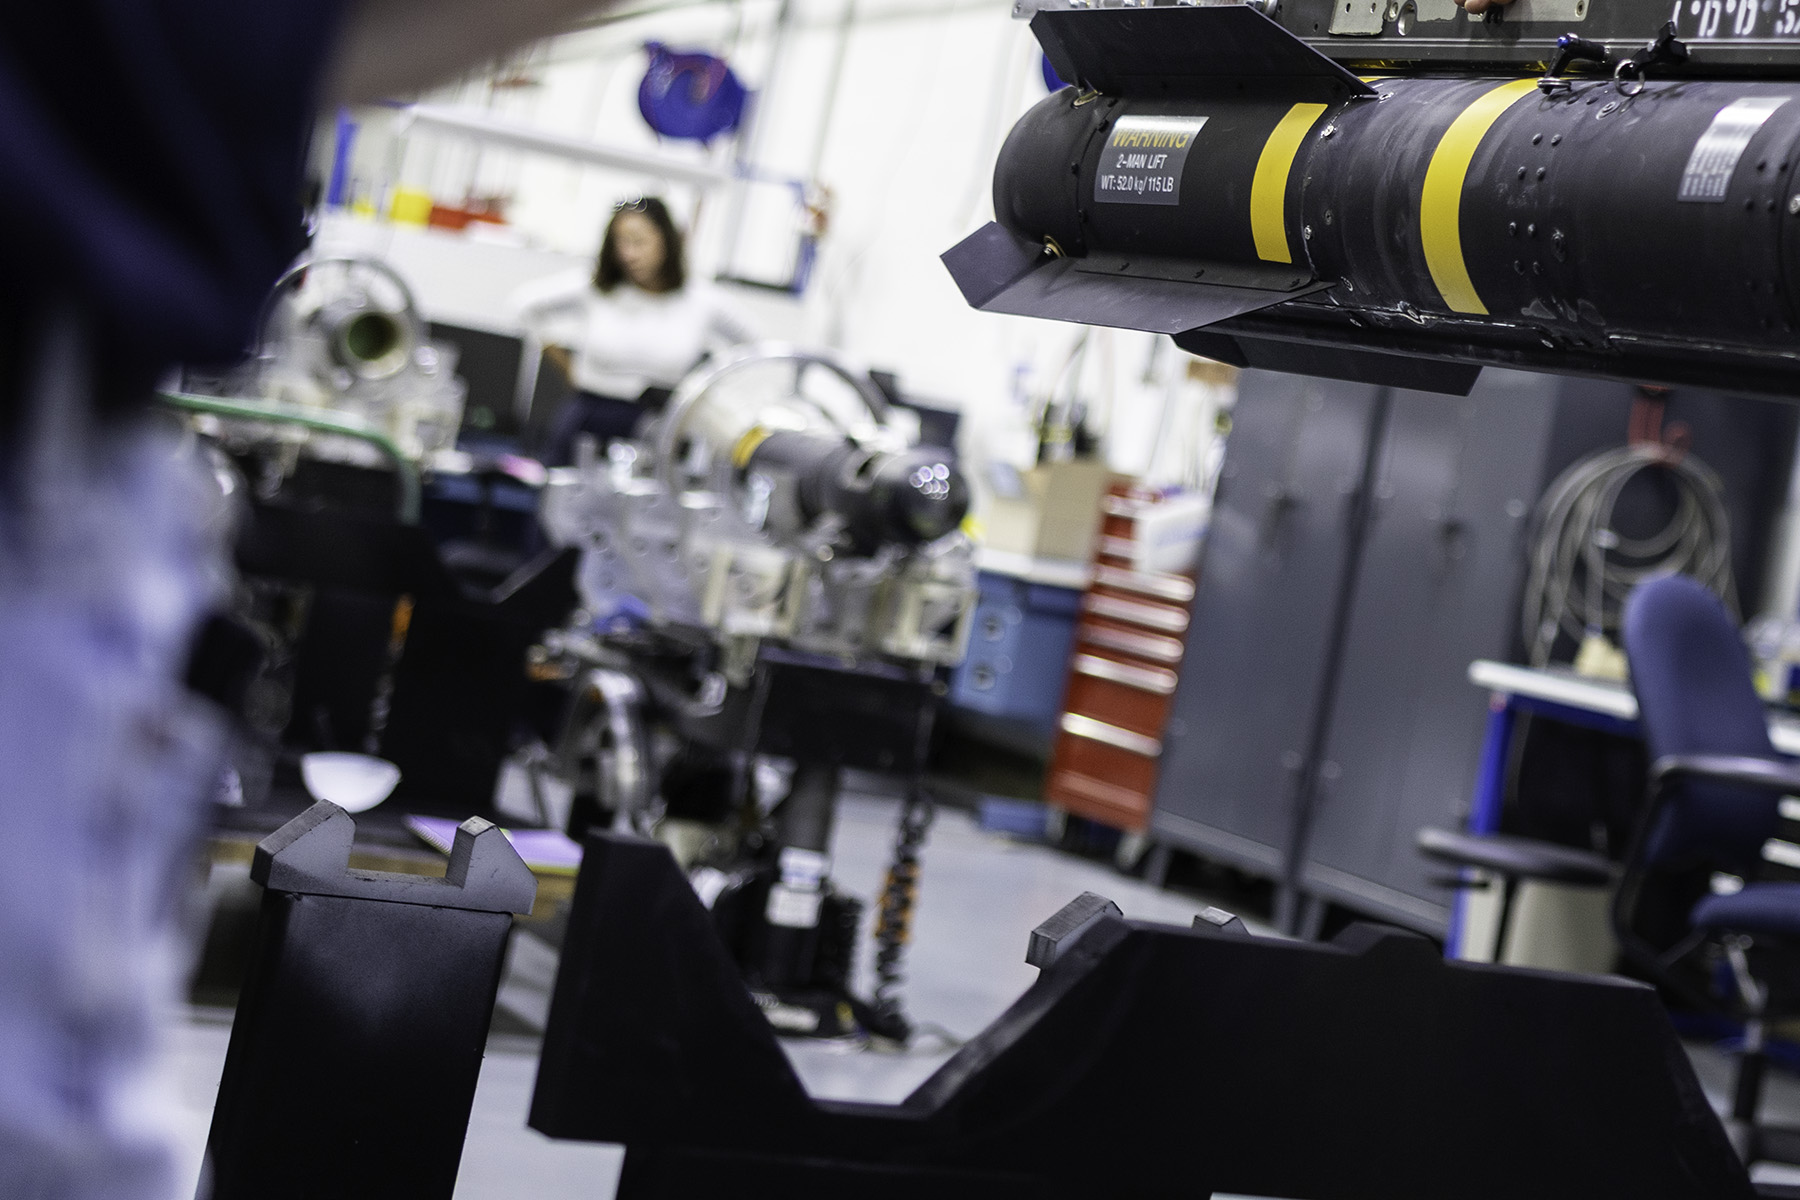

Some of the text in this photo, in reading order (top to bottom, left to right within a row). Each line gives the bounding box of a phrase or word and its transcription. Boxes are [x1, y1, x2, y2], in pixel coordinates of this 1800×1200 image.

[1112, 129, 1191, 149] WARNING
[1116, 153, 1168, 170] 2-MAN LIFT
[1101, 174, 1116, 191] WT:
[1116, 175, 1133, 191] 52.0
[1162, 177, 1174, 193] LB
